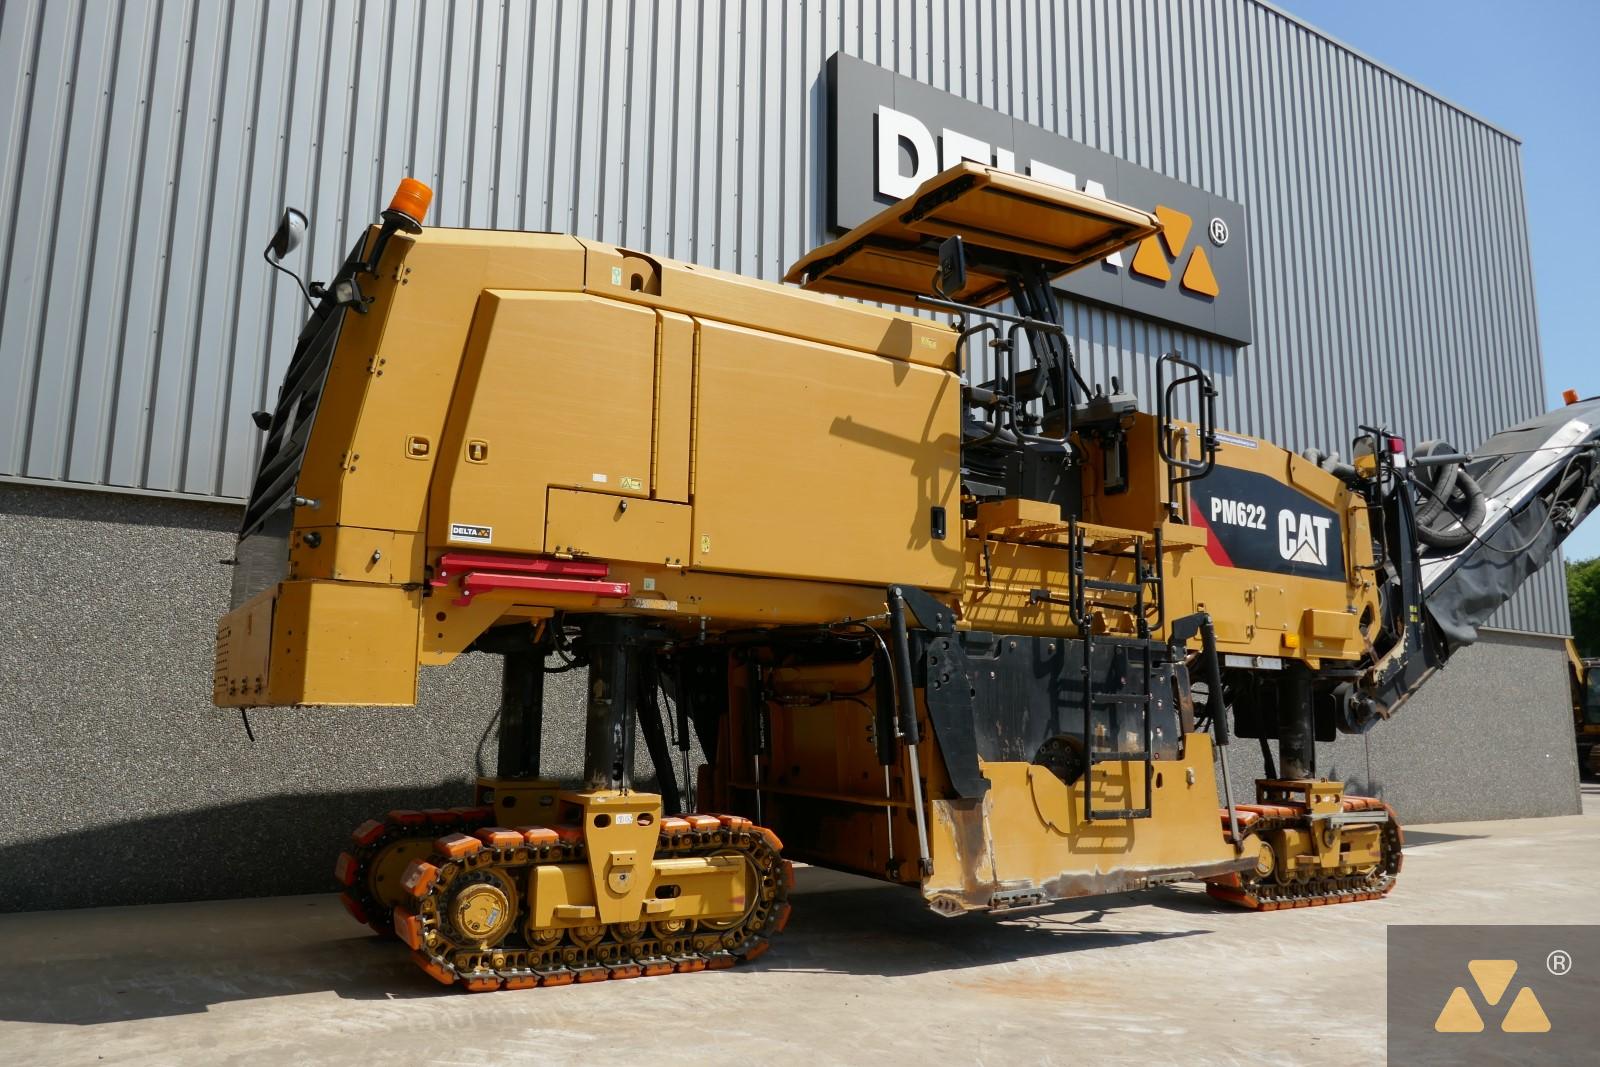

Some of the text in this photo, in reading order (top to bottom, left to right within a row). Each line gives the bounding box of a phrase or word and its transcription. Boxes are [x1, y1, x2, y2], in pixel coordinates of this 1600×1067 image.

[1211, 496, 1267, 530] PM622
[453, 527, 478, 536] DELTA
[1278, 508, 1331, 567] CAT
